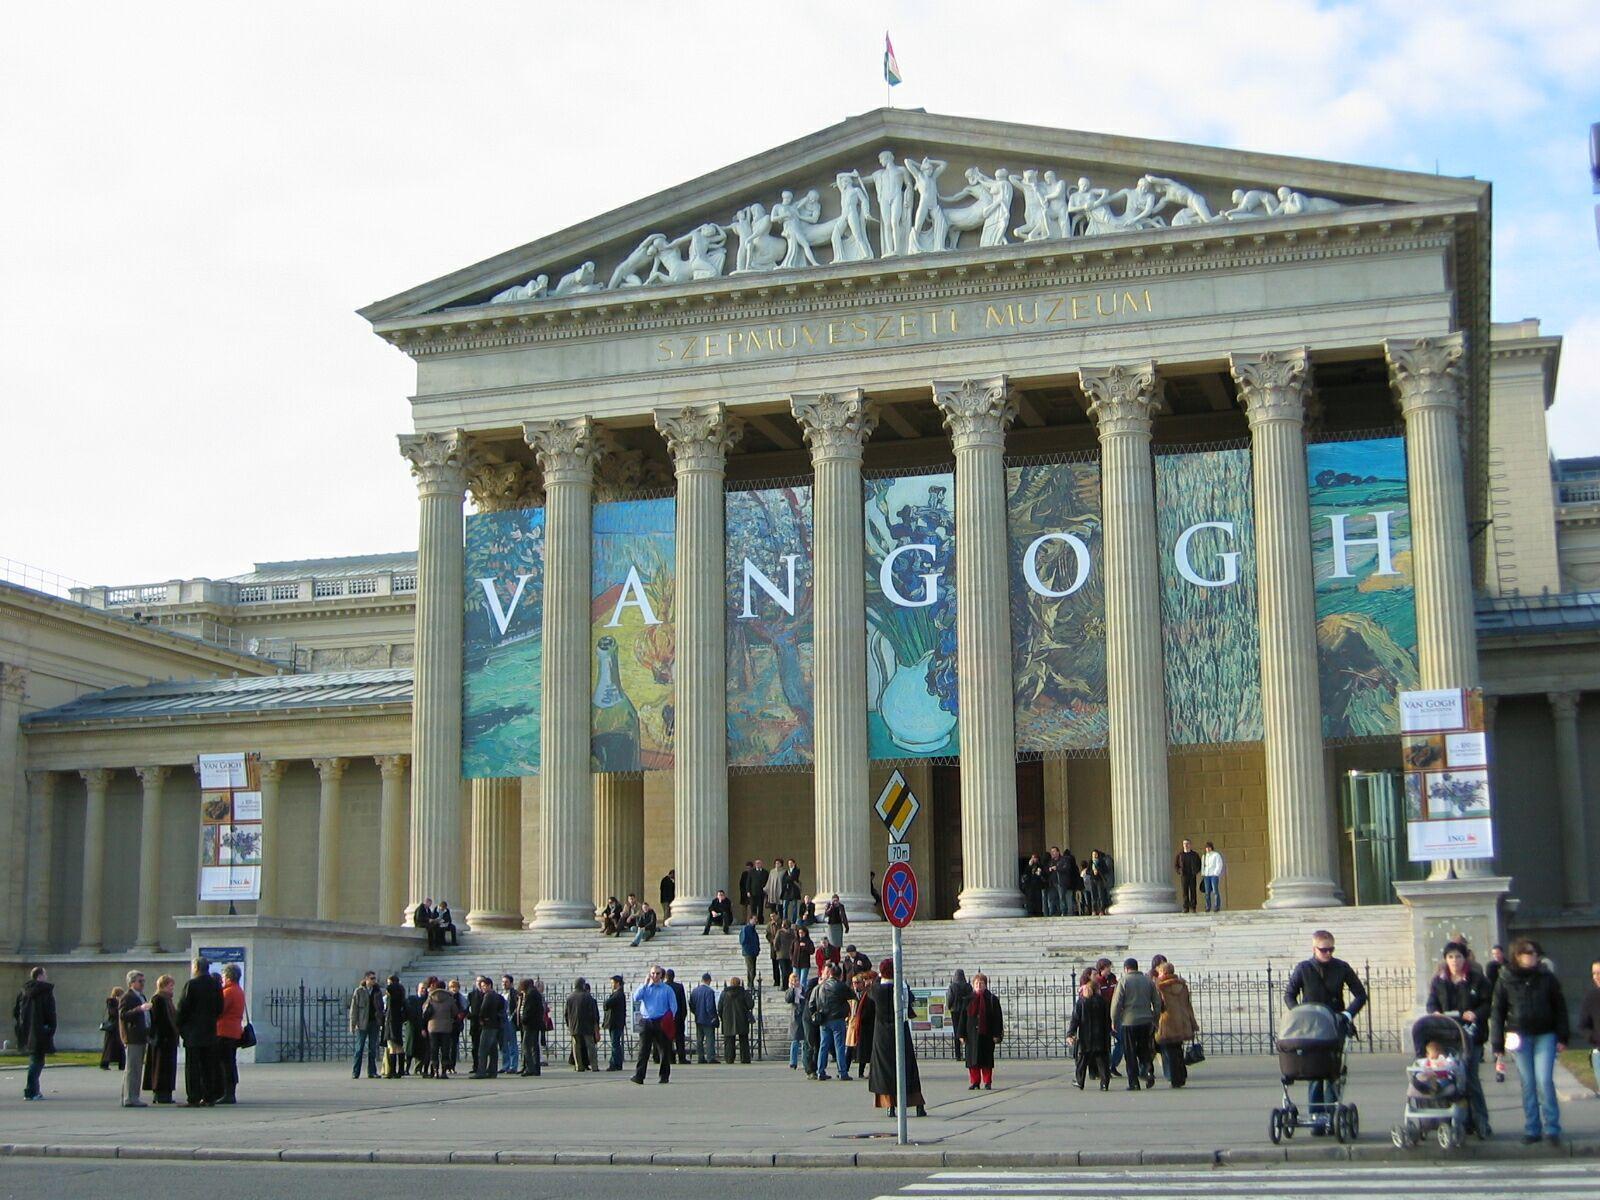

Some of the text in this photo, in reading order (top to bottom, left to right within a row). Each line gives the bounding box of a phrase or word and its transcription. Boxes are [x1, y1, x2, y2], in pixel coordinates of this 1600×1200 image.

[1404, 699, 1456, 709] VAN GOGH
[220, 761, 242, 769] GOGH
[1447, 834, 1465, 842] ING
[893, 846, 908, 860] 70m
